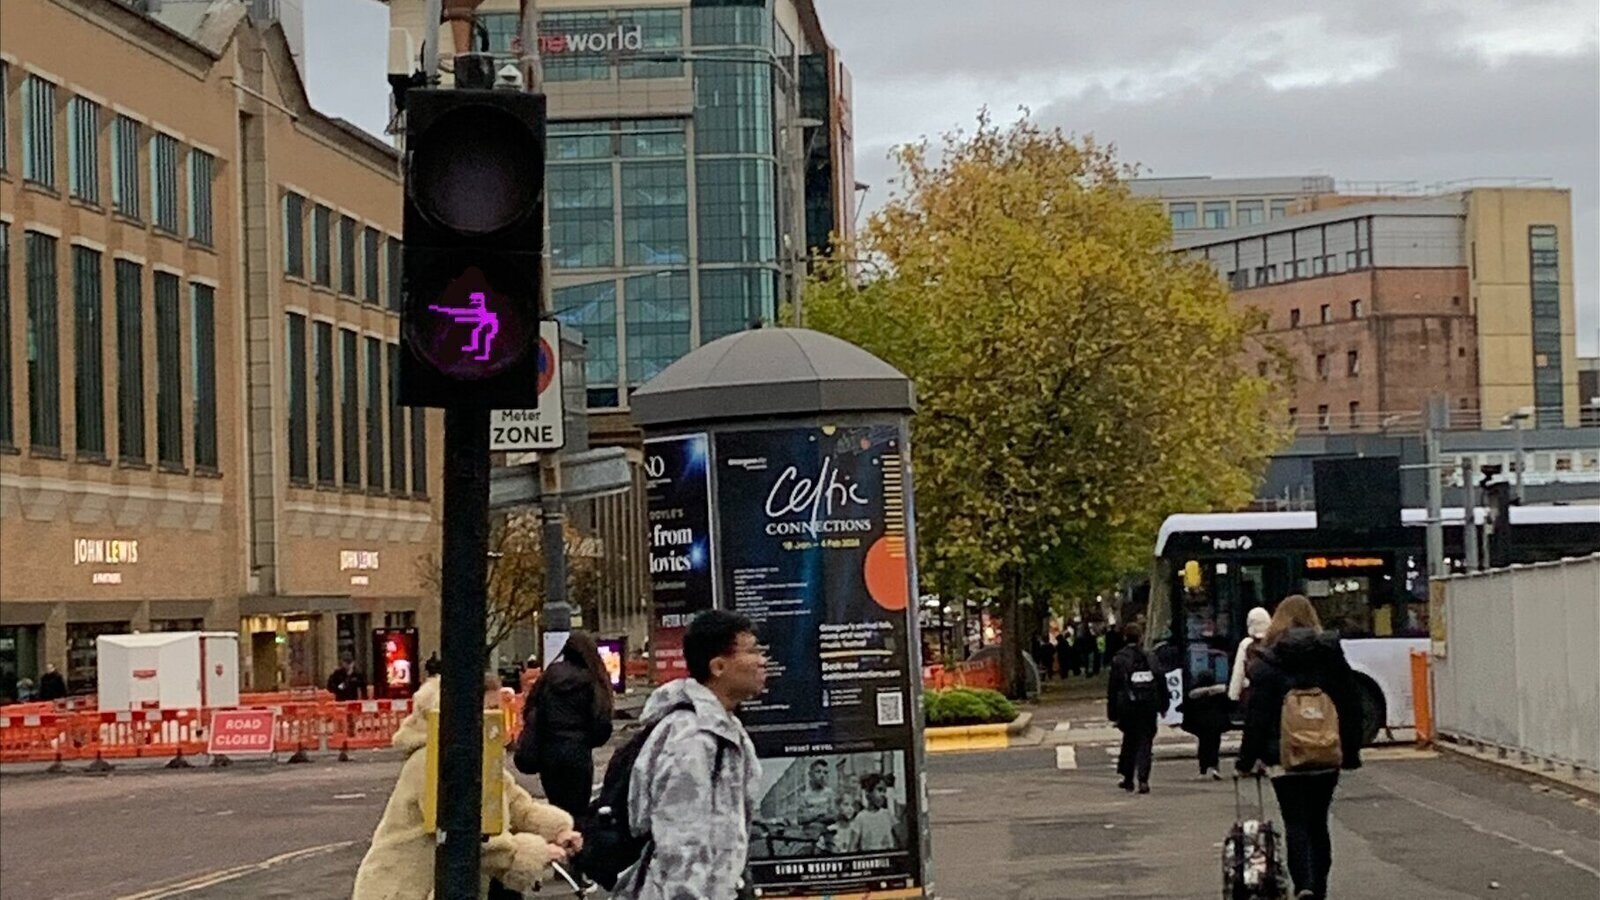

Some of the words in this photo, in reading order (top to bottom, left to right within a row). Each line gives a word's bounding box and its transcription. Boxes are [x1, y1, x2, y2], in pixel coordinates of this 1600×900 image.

[502, 410, 541, 421] Meter
[493, 426, 553, 443] ZONE
[654, 524, 693, 546] from
[765, 519, 872, 535] CONNECTIONS
[74, 538, 104, 565] JOHN
[105, 540, 138, 563] LEWIS
[225, 719, 262, 730] ROAD
[215, 734, 268, 746] CLOSED
